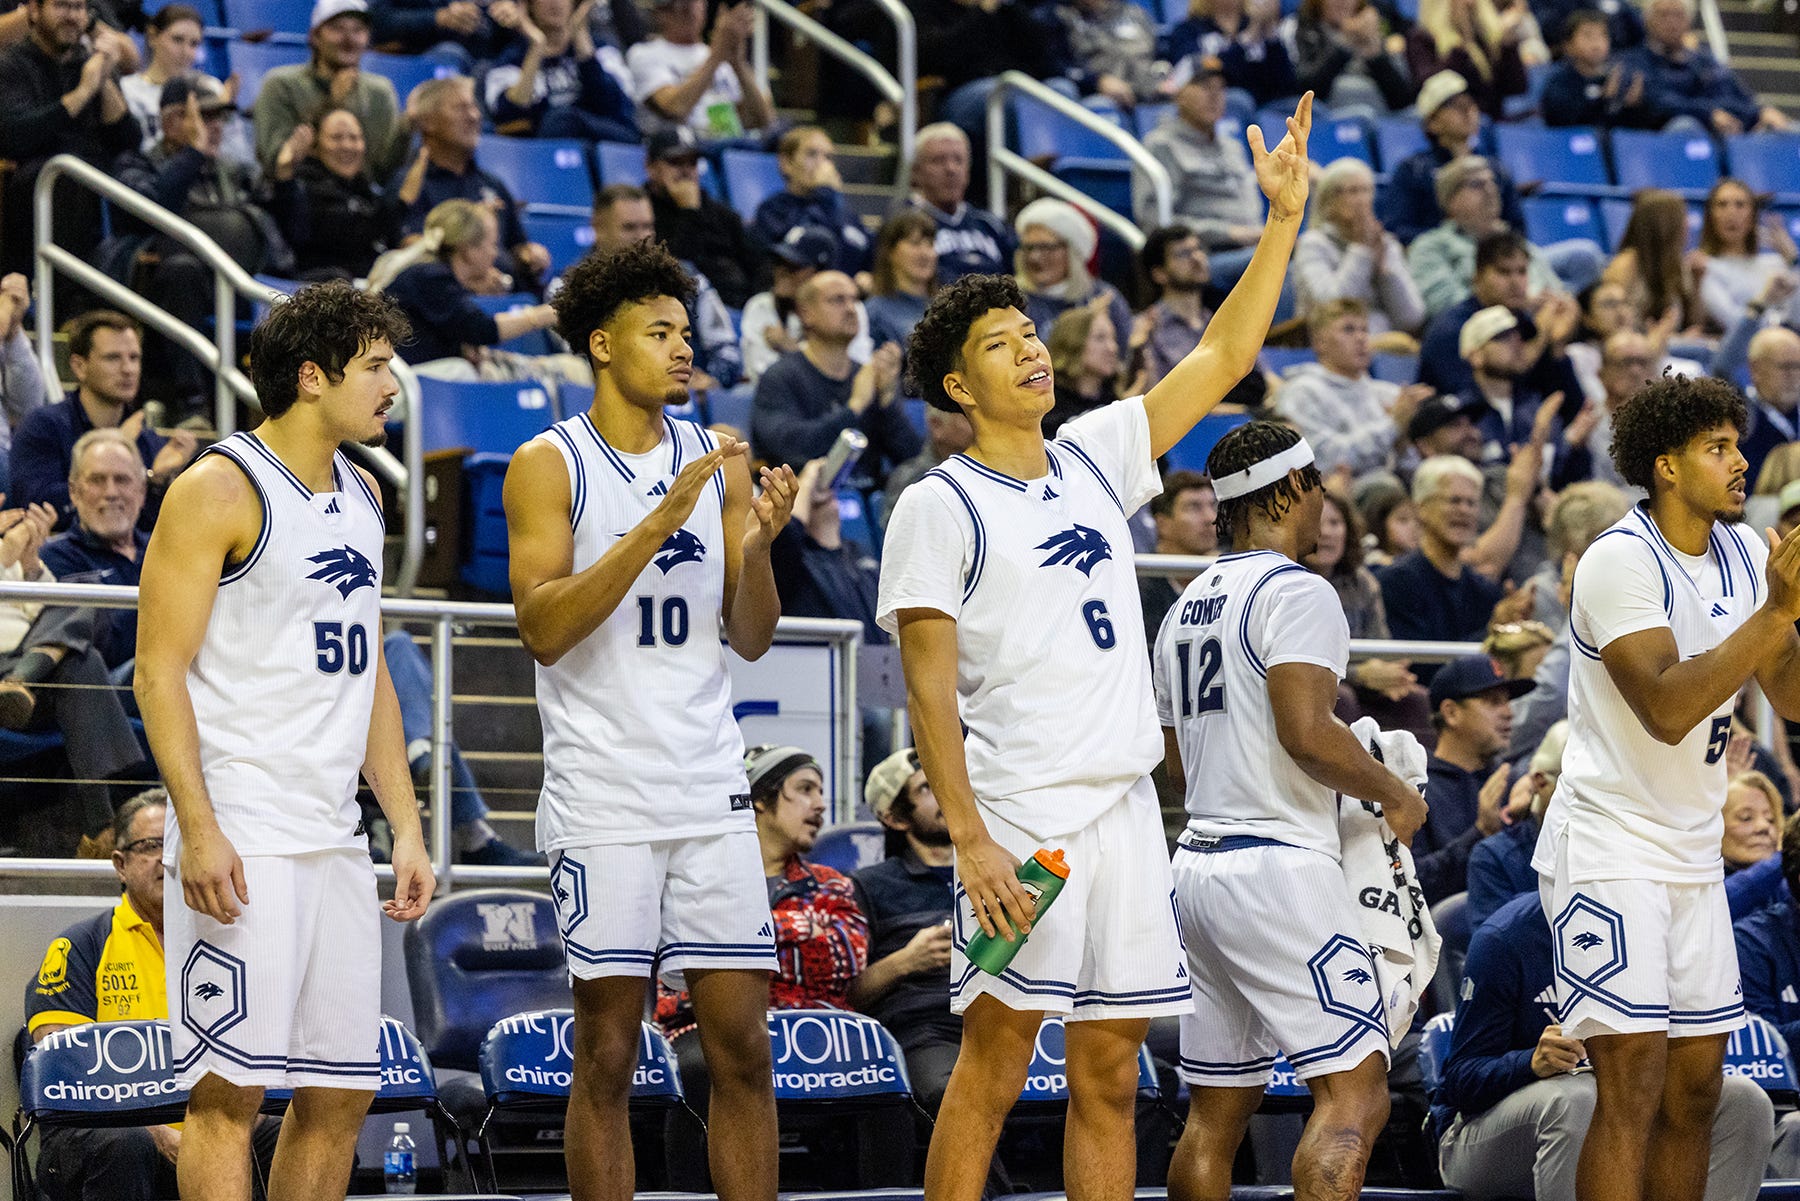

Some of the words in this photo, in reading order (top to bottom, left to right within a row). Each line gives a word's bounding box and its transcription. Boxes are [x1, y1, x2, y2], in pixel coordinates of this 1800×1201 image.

[636, 594, 690, 648] 10
[1080, 597, 1117, 652] 6
[312, 620, 368, 678] 50
[1175, 635, 1228, 720] 12
[1704, 712, 1733, 766] 5
[102, 974, 138, 991] 5012
[777, 1016, 884, 1065] JOINT
[44, 1078, 178, 1103] chiroprac
[771, 1064, 896, 1092] iropractic
